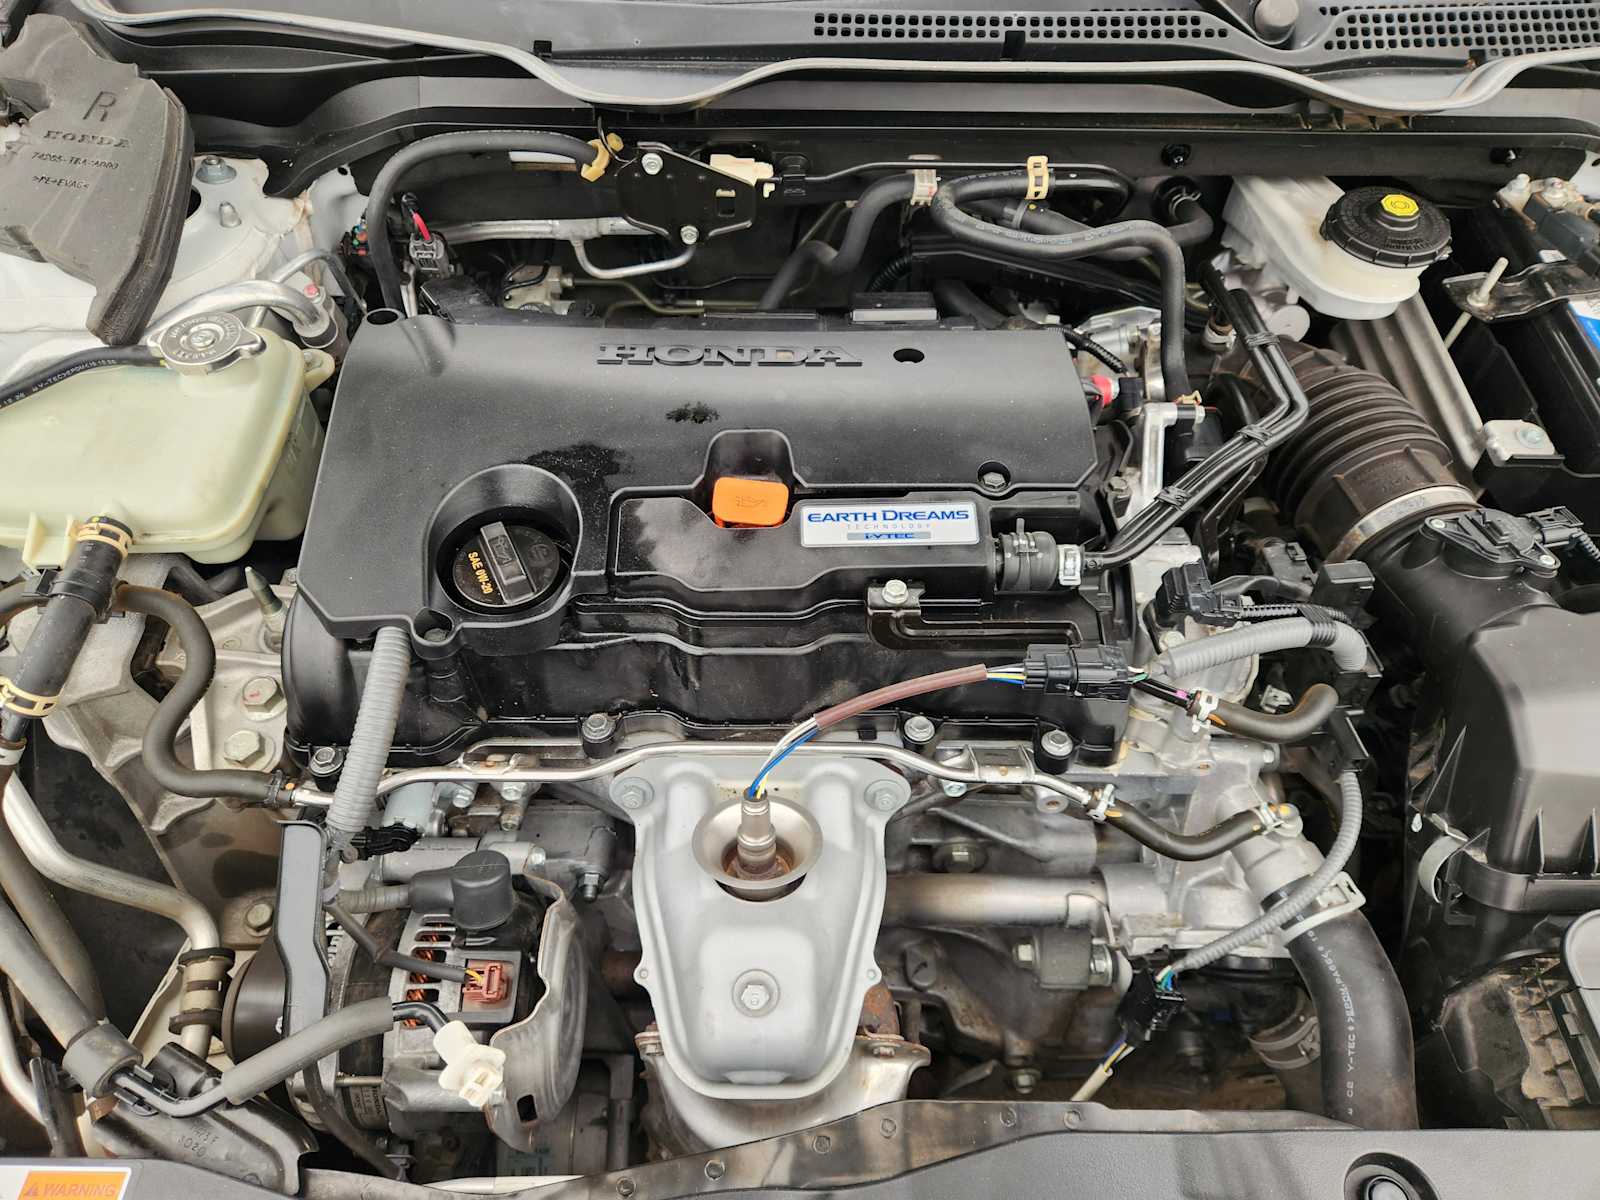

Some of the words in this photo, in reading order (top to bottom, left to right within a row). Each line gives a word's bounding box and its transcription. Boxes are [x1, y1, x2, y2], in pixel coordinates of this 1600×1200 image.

[83, 91, 117, 122] R
[597, 345, 863, 367] HONDA
[807, 512, 877, 523] EARTH
[882, 509, 970, 521] DREAMS
[468, 551, 483, 570] SAE
[475, 568, 494, 595] 0W-20
[42, 1183, 117, 1198] WARNING
